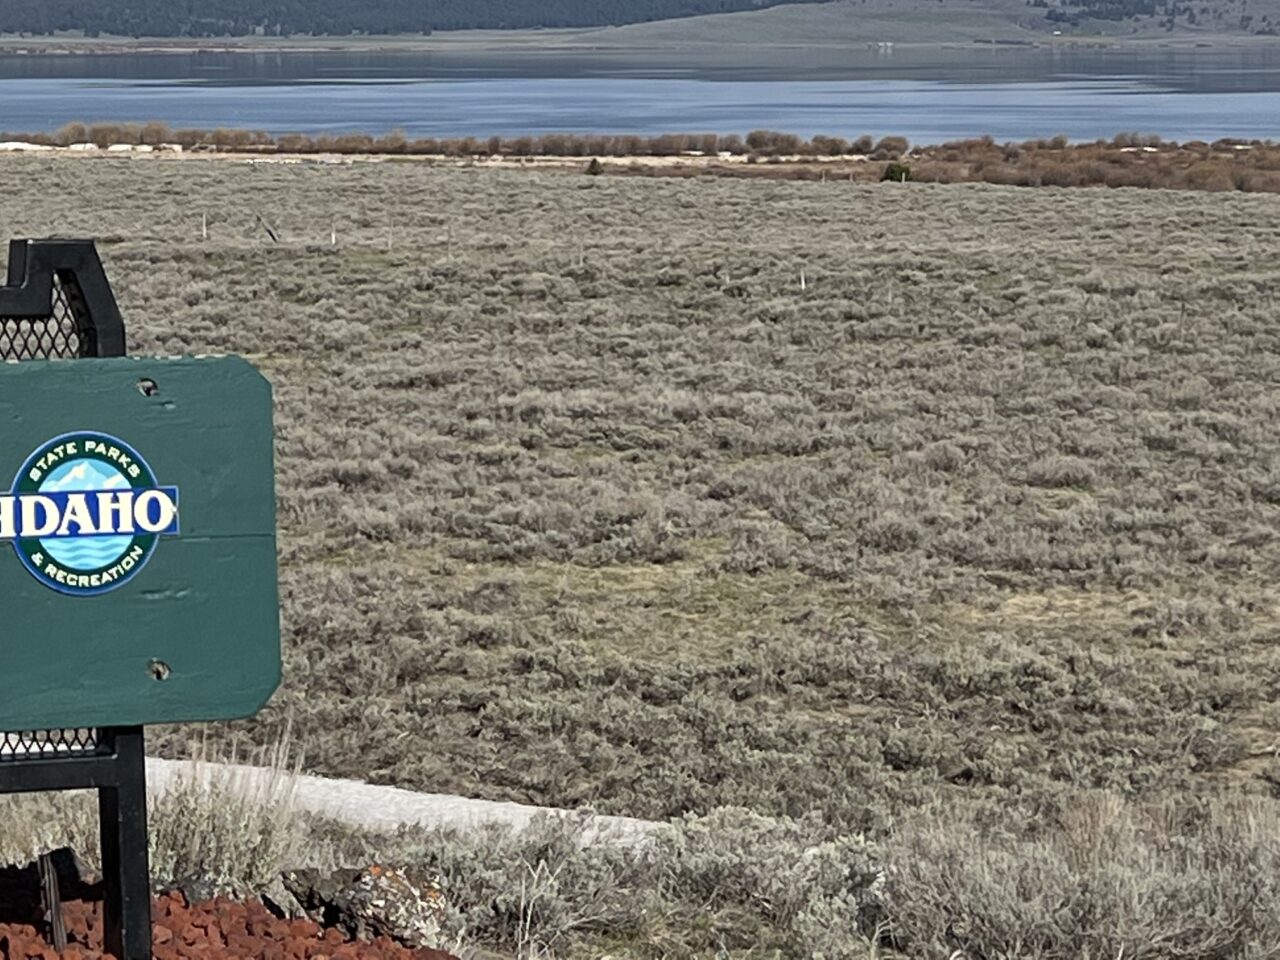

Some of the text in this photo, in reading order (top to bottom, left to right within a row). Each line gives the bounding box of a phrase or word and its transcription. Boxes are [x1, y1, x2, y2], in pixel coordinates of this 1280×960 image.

[28, 440, 141, 482] STATE PARKS
[31, 545, 144, 588] & RECREATION
